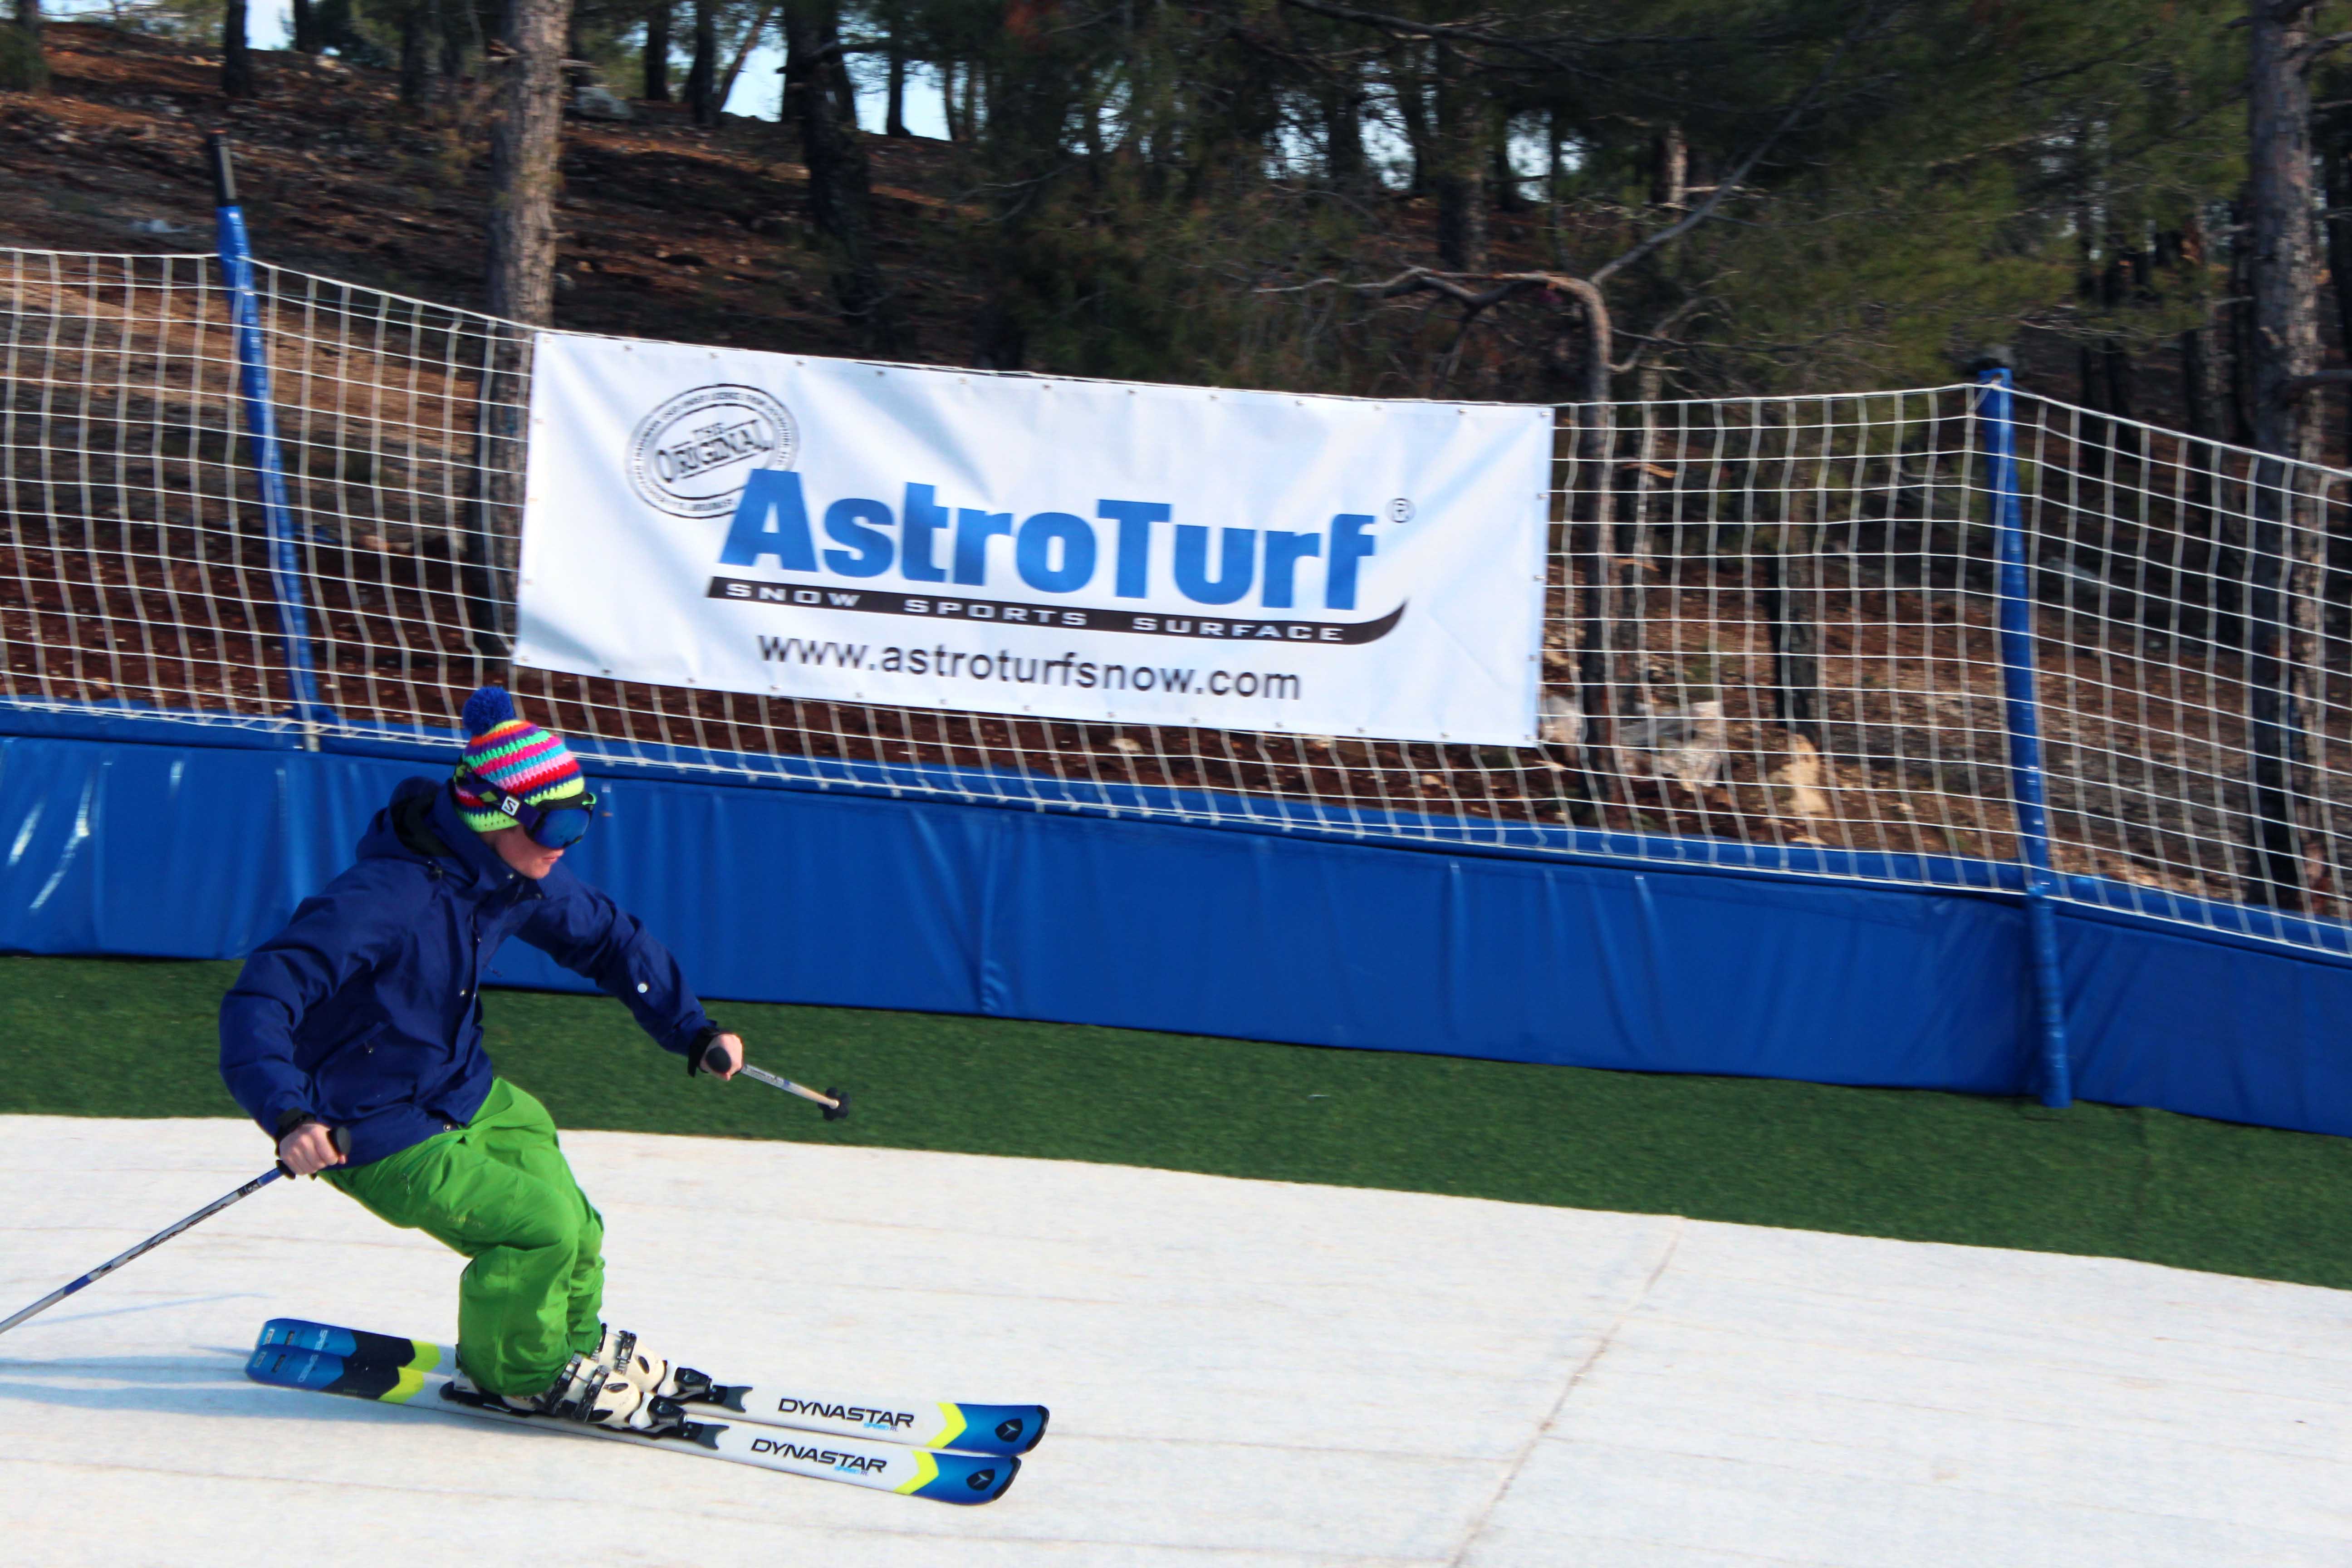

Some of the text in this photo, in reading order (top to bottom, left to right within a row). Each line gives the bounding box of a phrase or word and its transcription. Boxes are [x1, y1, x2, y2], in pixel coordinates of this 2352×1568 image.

[718, 468, 1376, 610] AstroTurf
[727, 583, 1344, 642] SNOW SPORTS SURFACE
[758, 635, 1300, 700] www.astroturfsnow.com
[778, 1398, 914, 1428] DYNASTAR
[750, 1438, 887, 1473] DYNASTAR
